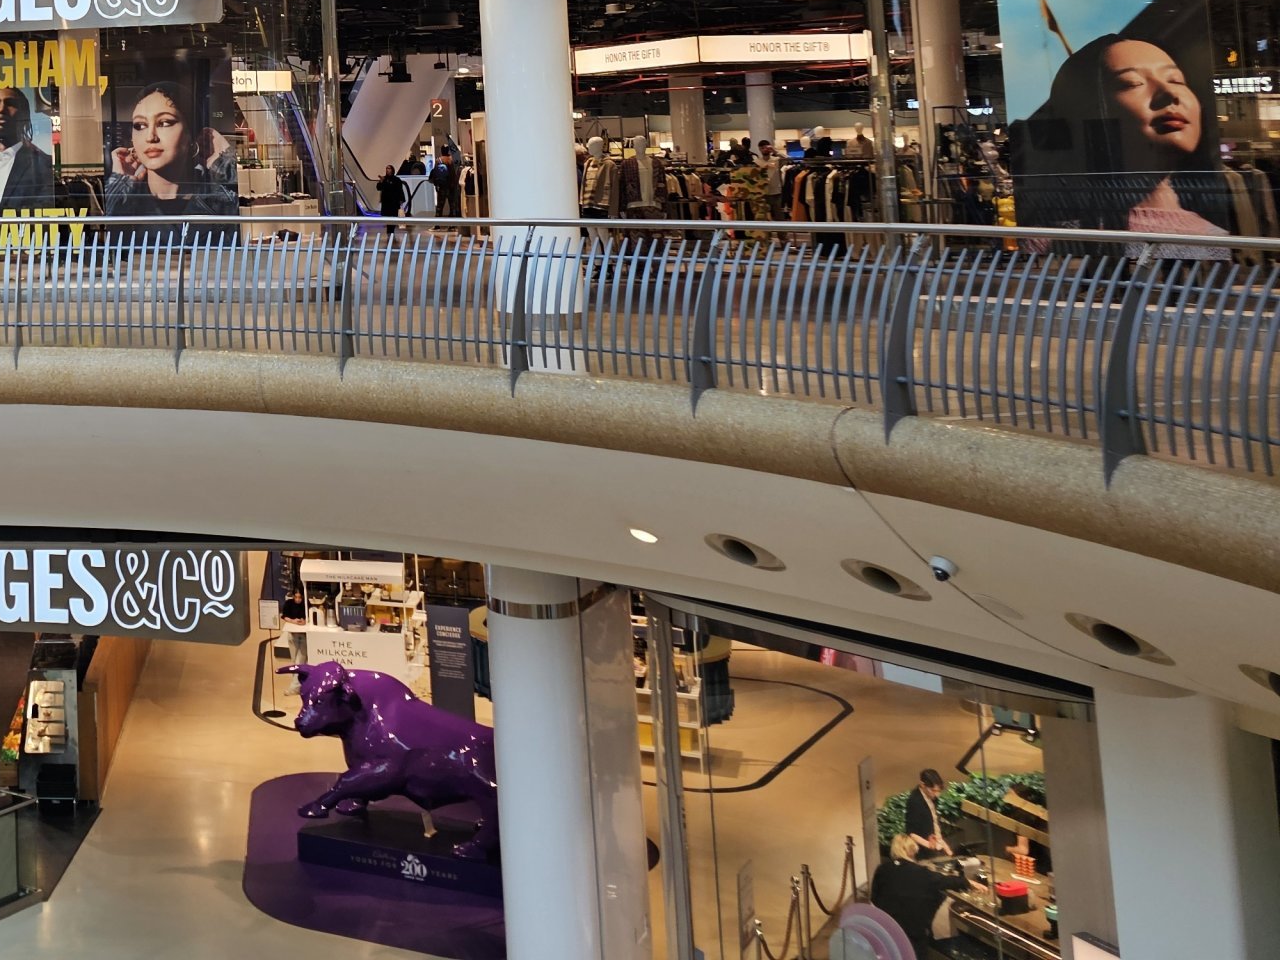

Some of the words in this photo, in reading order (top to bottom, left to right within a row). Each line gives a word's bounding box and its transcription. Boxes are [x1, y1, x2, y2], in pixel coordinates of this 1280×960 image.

[749, 41, 782, 54] HONOR
[784, 41, 801, 53] THE
[605, 51, 627, 64] HONOR
[627, 50, 640, 62] THE
[432, 102, 443, 118] 2
[332, 640, 353, 649] THE
[317, 648, 368, 658] MILKCAKE
[400, 859, 428, 879] 200
